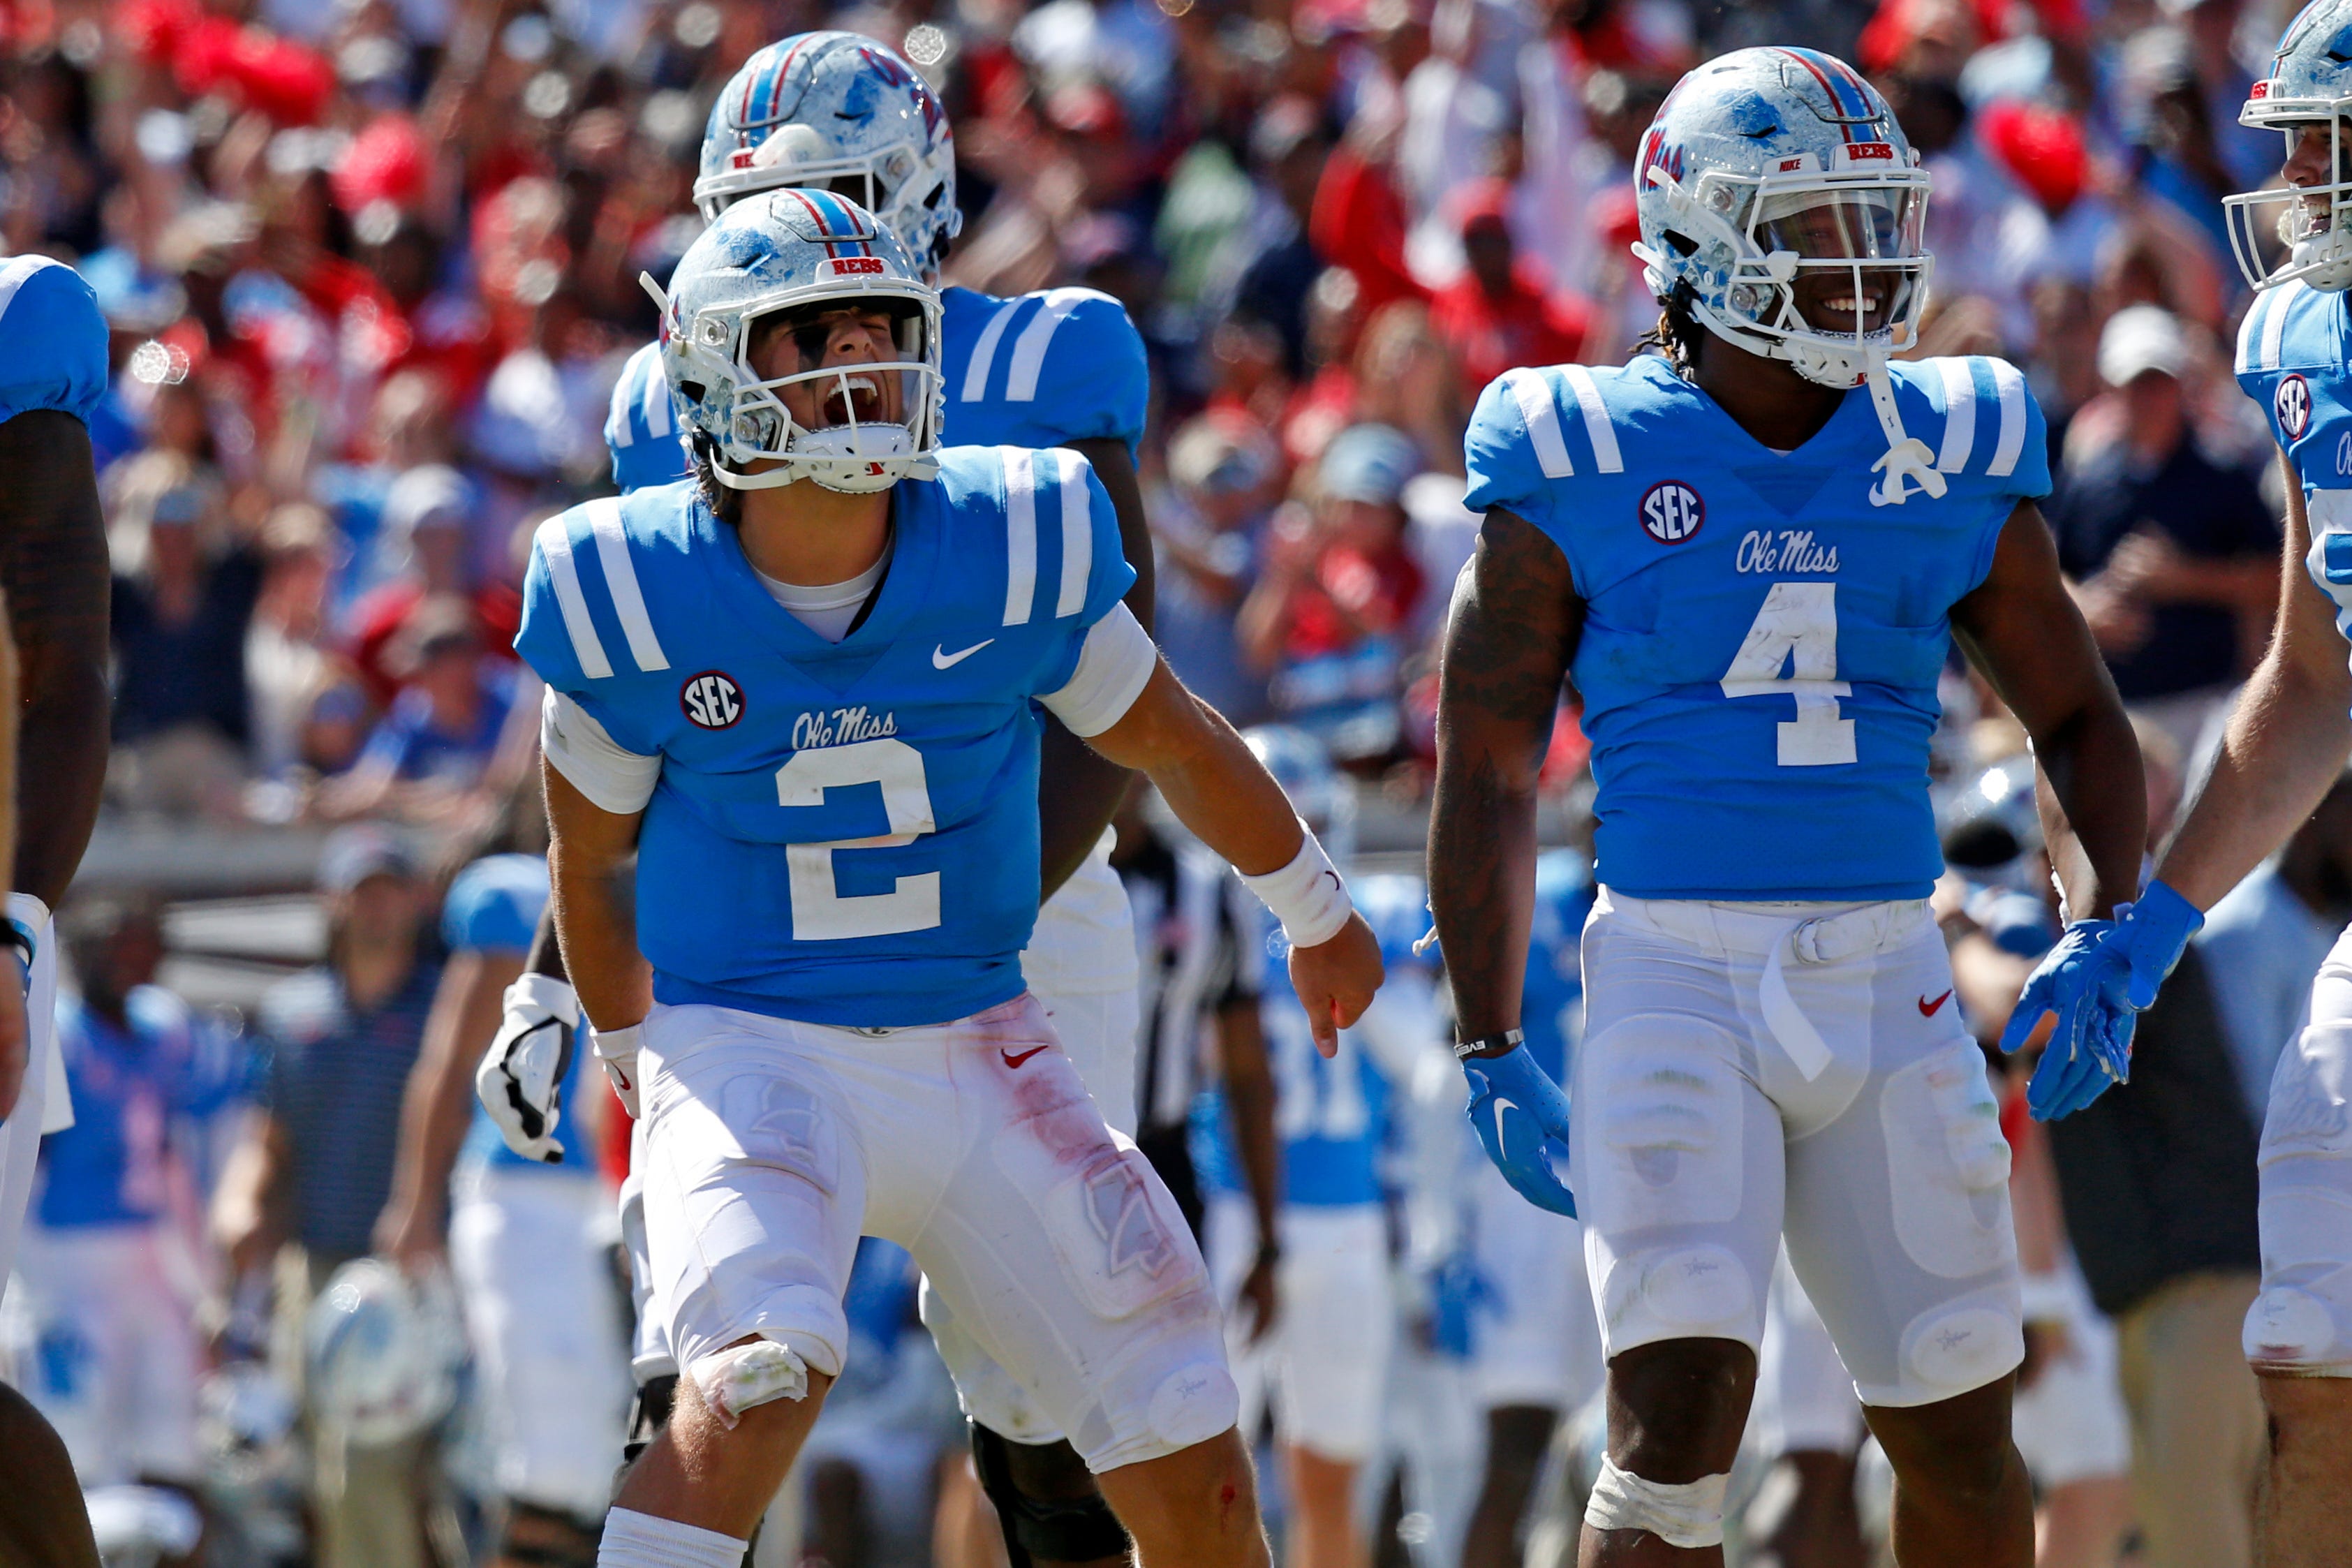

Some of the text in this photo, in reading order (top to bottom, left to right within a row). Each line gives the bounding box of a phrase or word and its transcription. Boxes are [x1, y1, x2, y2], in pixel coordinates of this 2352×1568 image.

[732, 153, 755, 169] RE
[1780, 158, 1802, 173] NIKE
[1847, 143, 1893, 161] REBS
[831, 258, 885, 276] REBS
[1644, 485, 1699, 540] SEC
[1736, 530, 1840, 573] Ole Miss
[1719, 582, 1858, 766] 4
[684, 675, 741, 727] SEC
[792, 705, 898, 750] Ole Miss
[775, 737, 941, 941] 2
